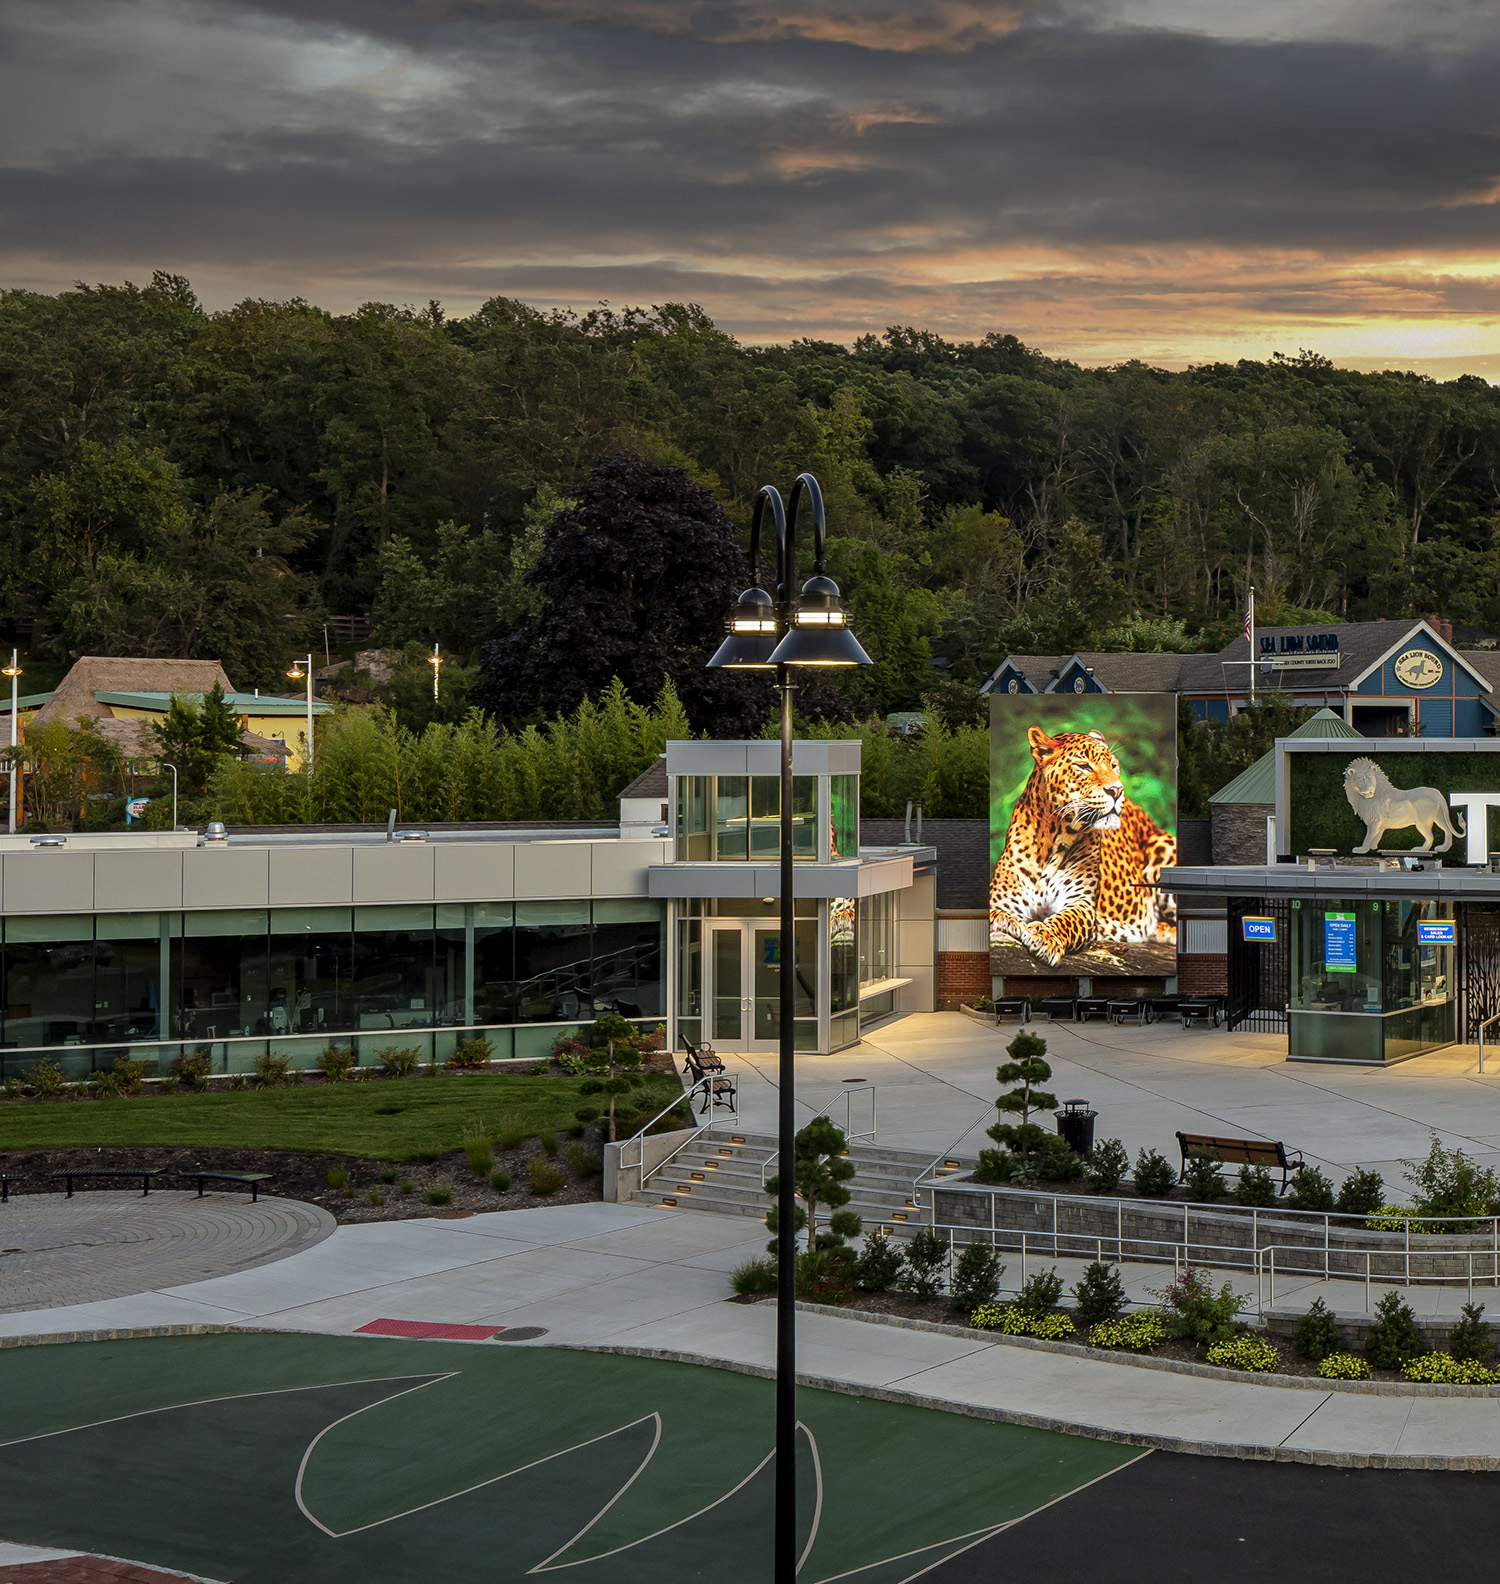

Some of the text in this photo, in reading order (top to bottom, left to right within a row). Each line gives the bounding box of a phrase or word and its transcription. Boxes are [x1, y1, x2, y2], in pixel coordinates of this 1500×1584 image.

[1260, 633, 1339, 653] SEA LION SOUND
[1398, 655, 1409, 665] SEA
[1424, 653, 1441, 669] SOUND
[1291, 900, 1300, 909] 10
[1372, 902, 1379, 911] 9
[1248, 925, 1271, 933] OPEN
